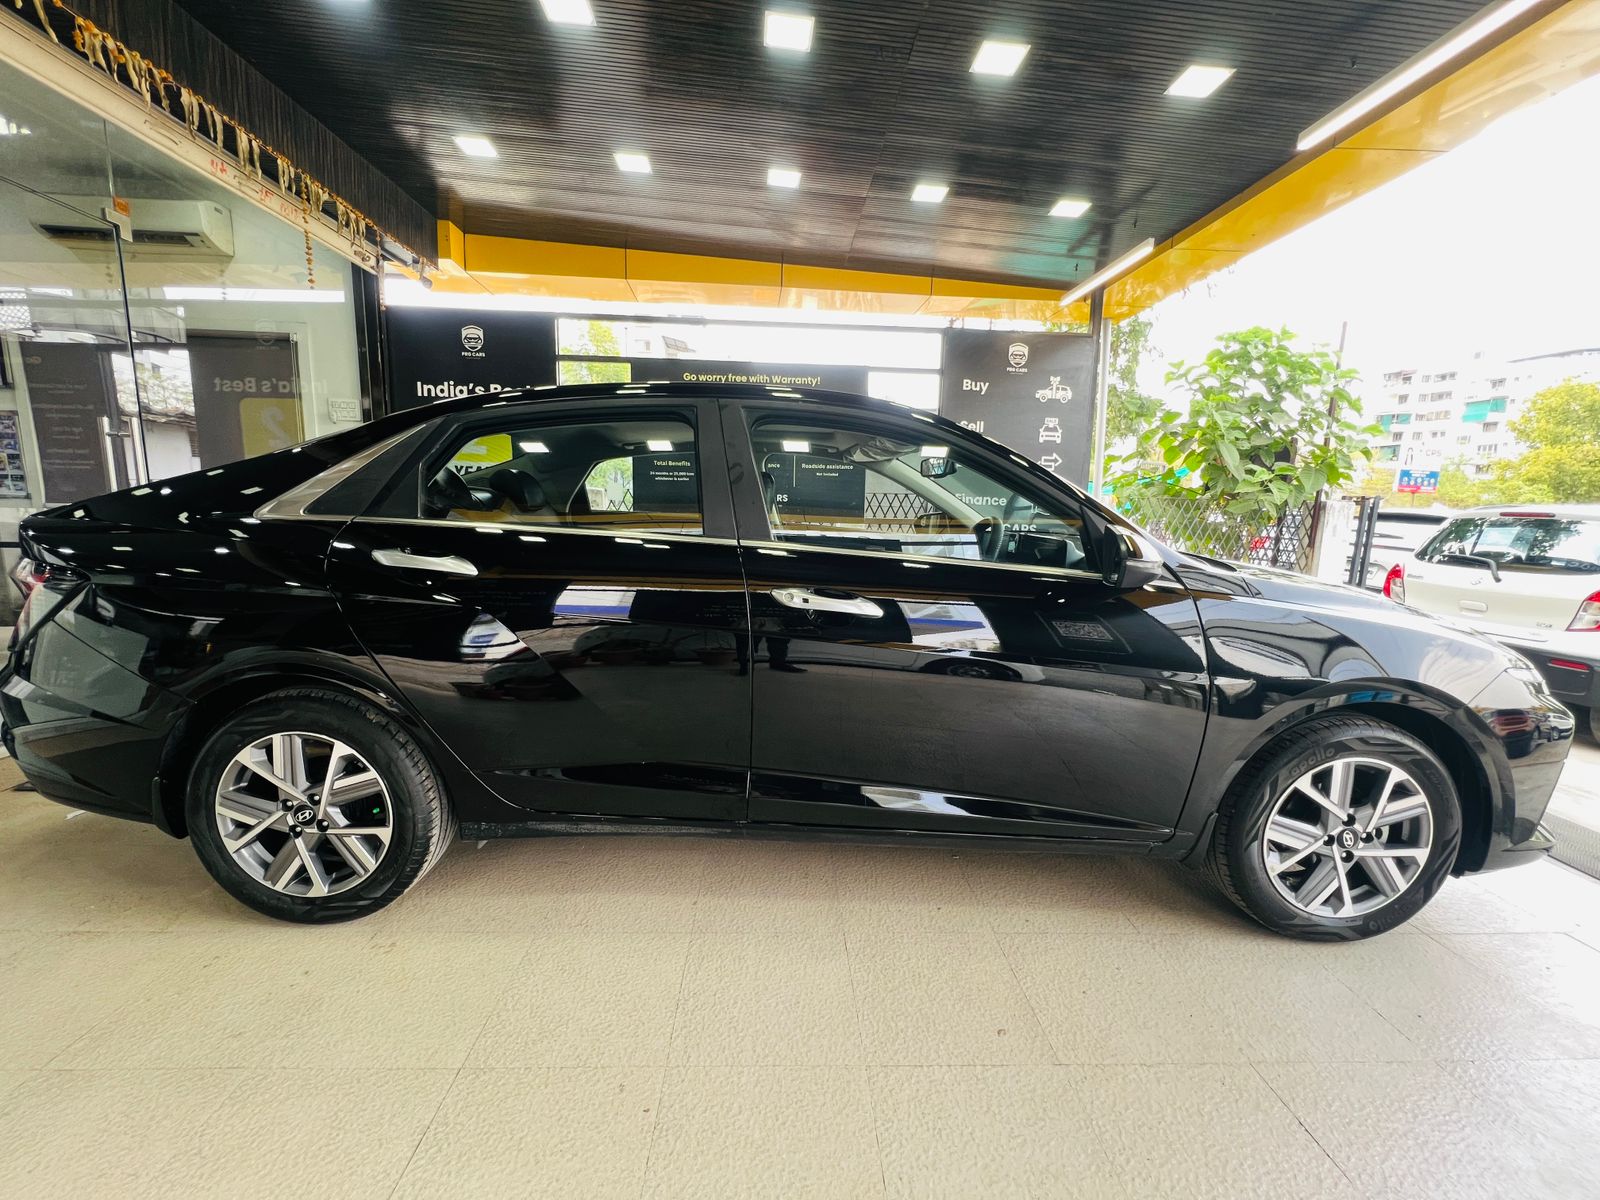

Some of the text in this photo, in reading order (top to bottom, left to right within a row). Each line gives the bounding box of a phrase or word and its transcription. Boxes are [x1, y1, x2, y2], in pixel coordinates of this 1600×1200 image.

[683, 372, 821, 387] Go worry free with Warranty!
[962, 379, 990, 395] Buy
[416, 380, 486, 398] India's
[776, 493, 789, 502] RS
[1289, 746, 1336, 776] apollo
